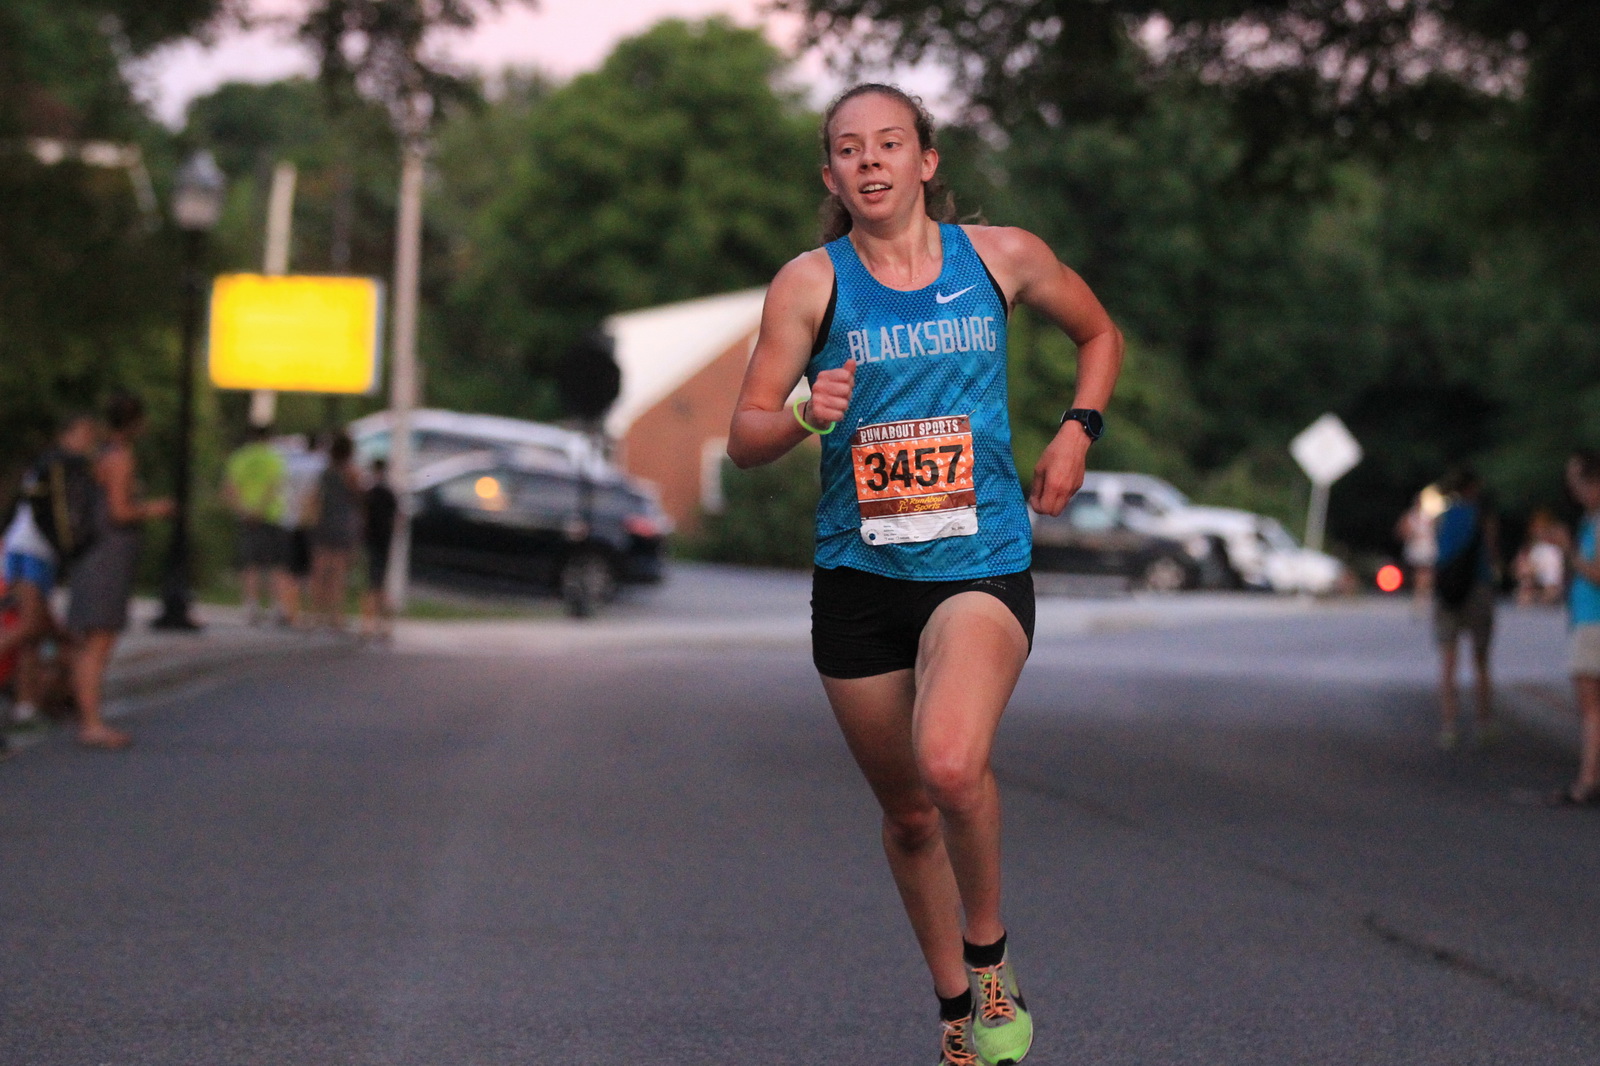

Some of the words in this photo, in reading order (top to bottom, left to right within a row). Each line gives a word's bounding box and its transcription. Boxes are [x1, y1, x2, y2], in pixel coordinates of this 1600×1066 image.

[847, 316, 996, 366] BLACKSBURG
[860, 424, 915, 443] RUNABOUT
[919, 419, 959, 435] SPORTS
[865, 444, 963, 491] 3457
